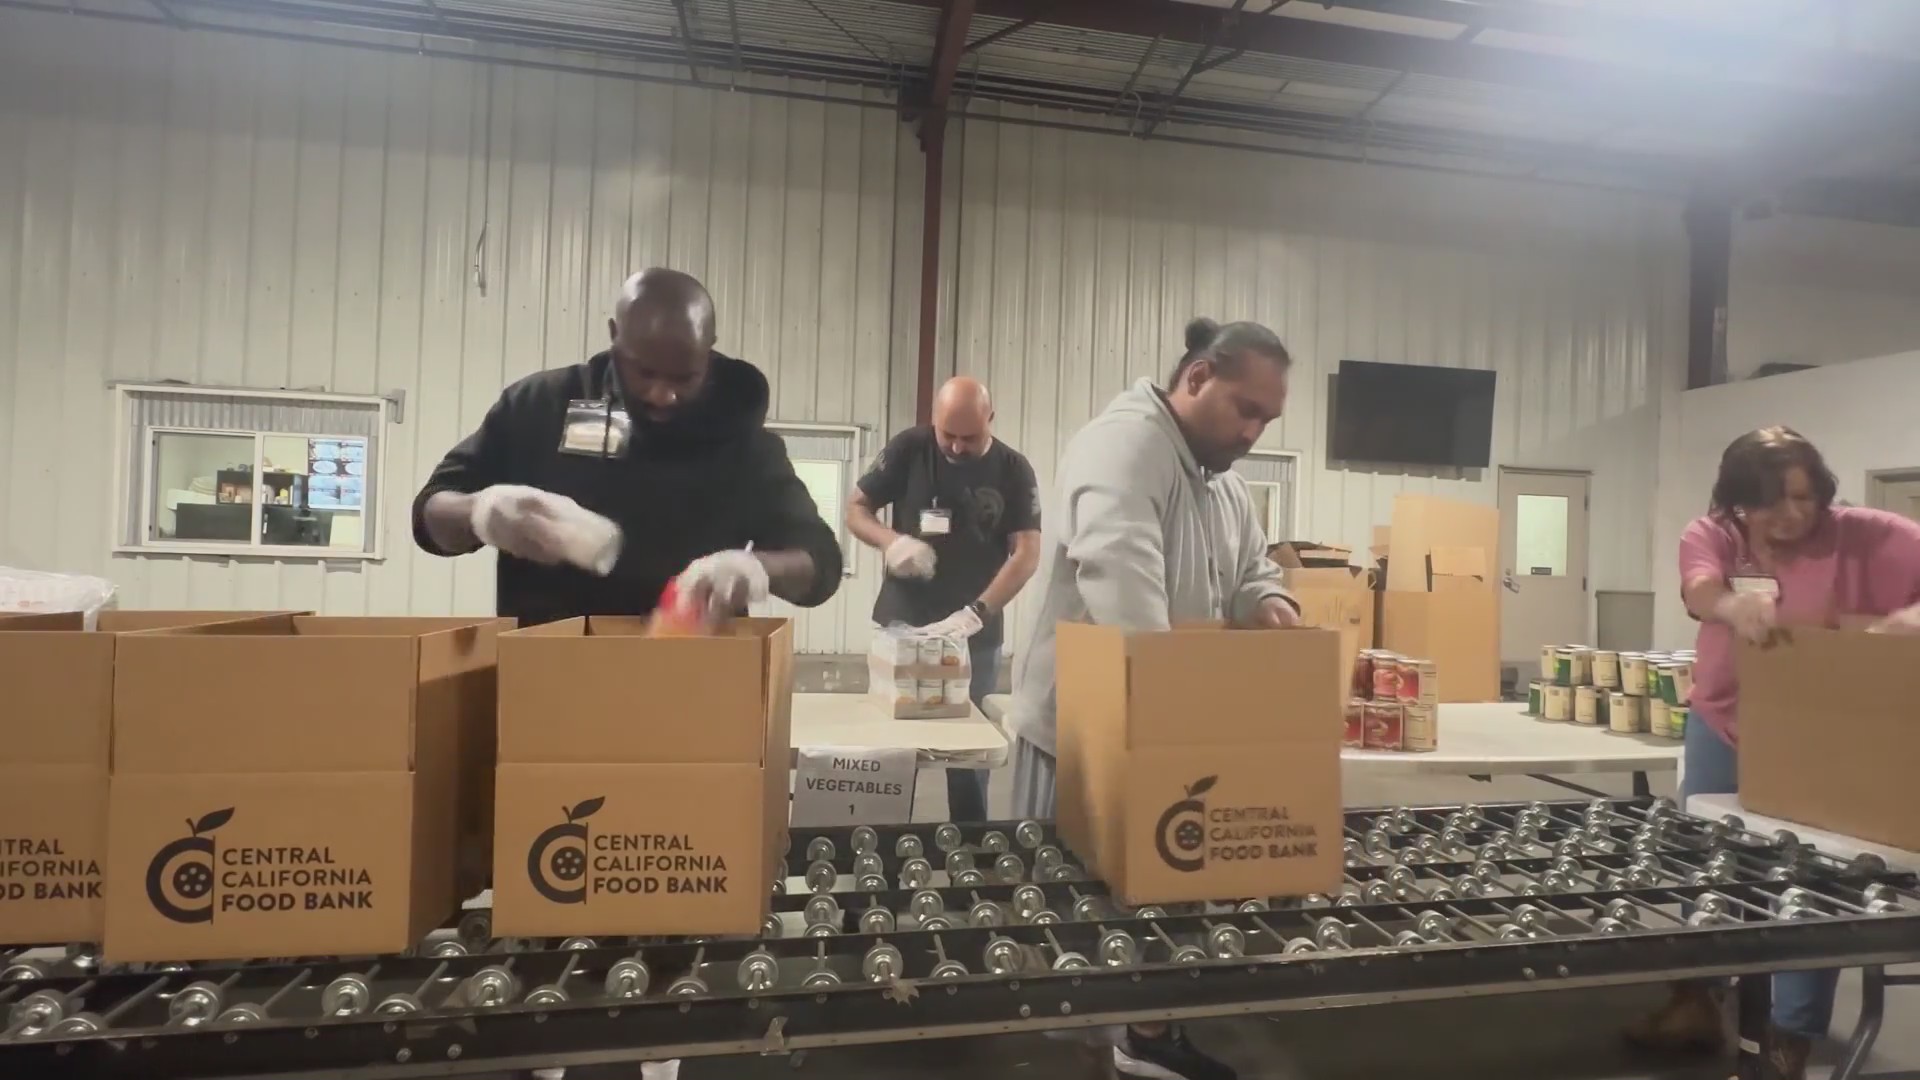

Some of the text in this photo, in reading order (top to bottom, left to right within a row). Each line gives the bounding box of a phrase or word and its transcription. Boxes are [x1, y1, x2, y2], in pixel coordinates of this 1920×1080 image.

[832, 757, 881, 772] MIXED
[806, 777, 902, 795] VEGETABLES
[848, 803, 855, 815] 1
[1209, 806, 1289, 823] CENTRAL
[1209, 824, 1318, 842] CALIFORNIA
[0, 838, 64, 855] TRAL
[593, 834, 694, 851] CENTRAL
[1210, 842, 1318, 861] FOOD BANK
[222, 846, 335, 865] CENTRAL
[593, 855, 727, 872] CALIFORNIA
[221, 868, 372, 888] CALIFORNIA
[593, 876, 728, 894] FOOD BANK
[34, 881, 103, 899] BANK
[221, 890, 373, 912] FOOD BANK
